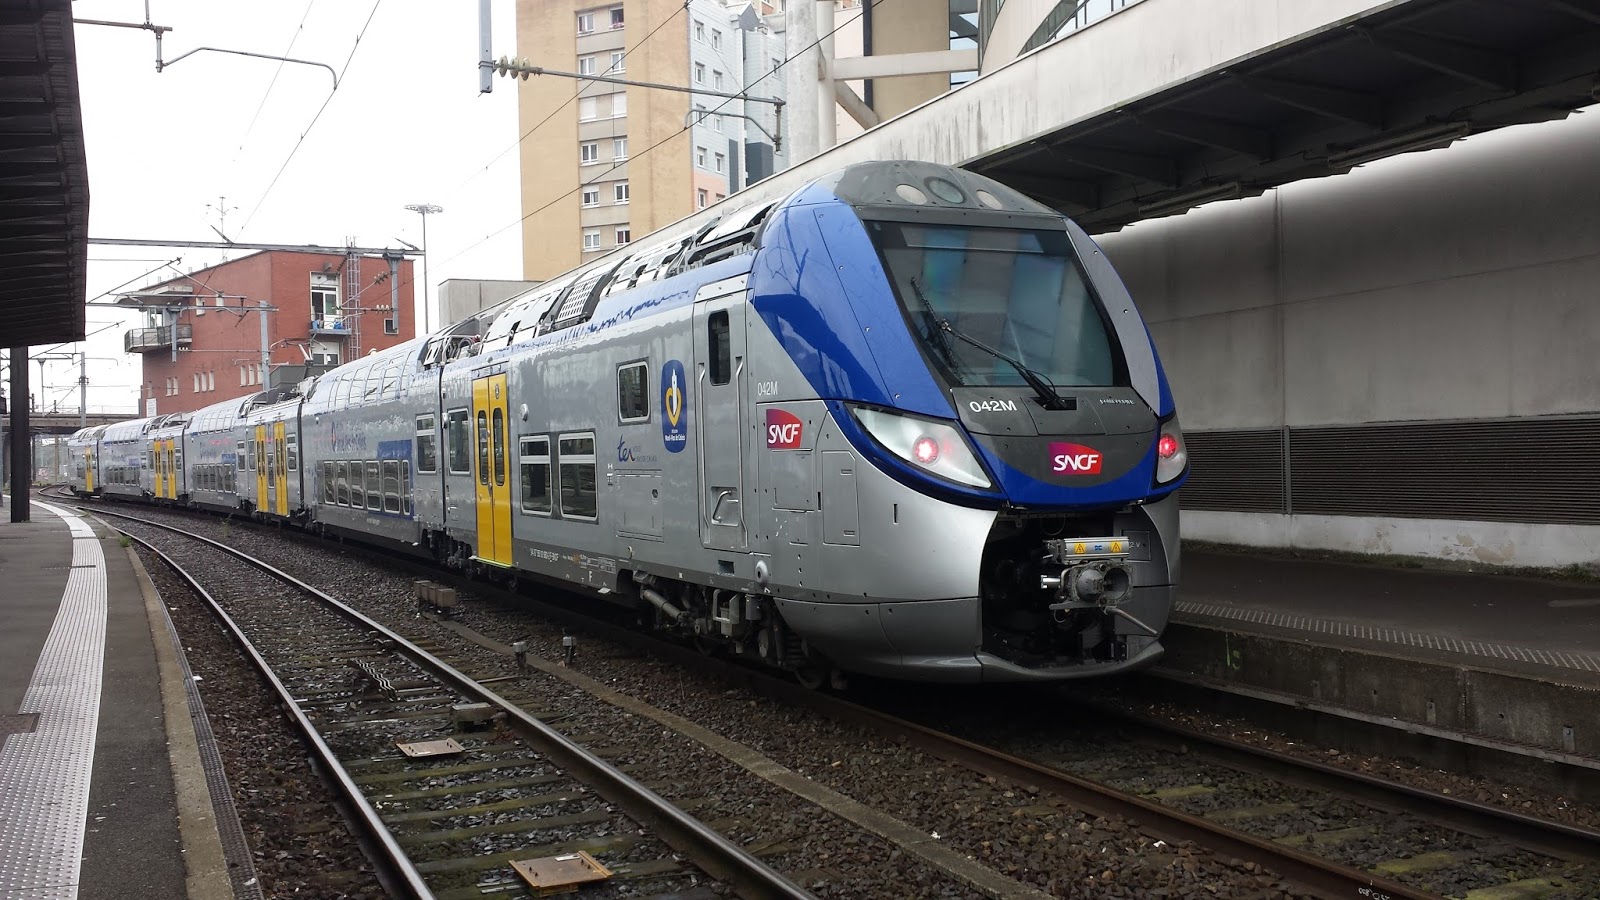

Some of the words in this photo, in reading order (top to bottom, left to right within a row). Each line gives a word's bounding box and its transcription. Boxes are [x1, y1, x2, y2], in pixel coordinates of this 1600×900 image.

[757, 381, 778, 396] 042M
[969, 399, 1018, 413] 042M
[767, 423, 801, 444] SNCF
[1053, 454, 1099, 472] SNCF
